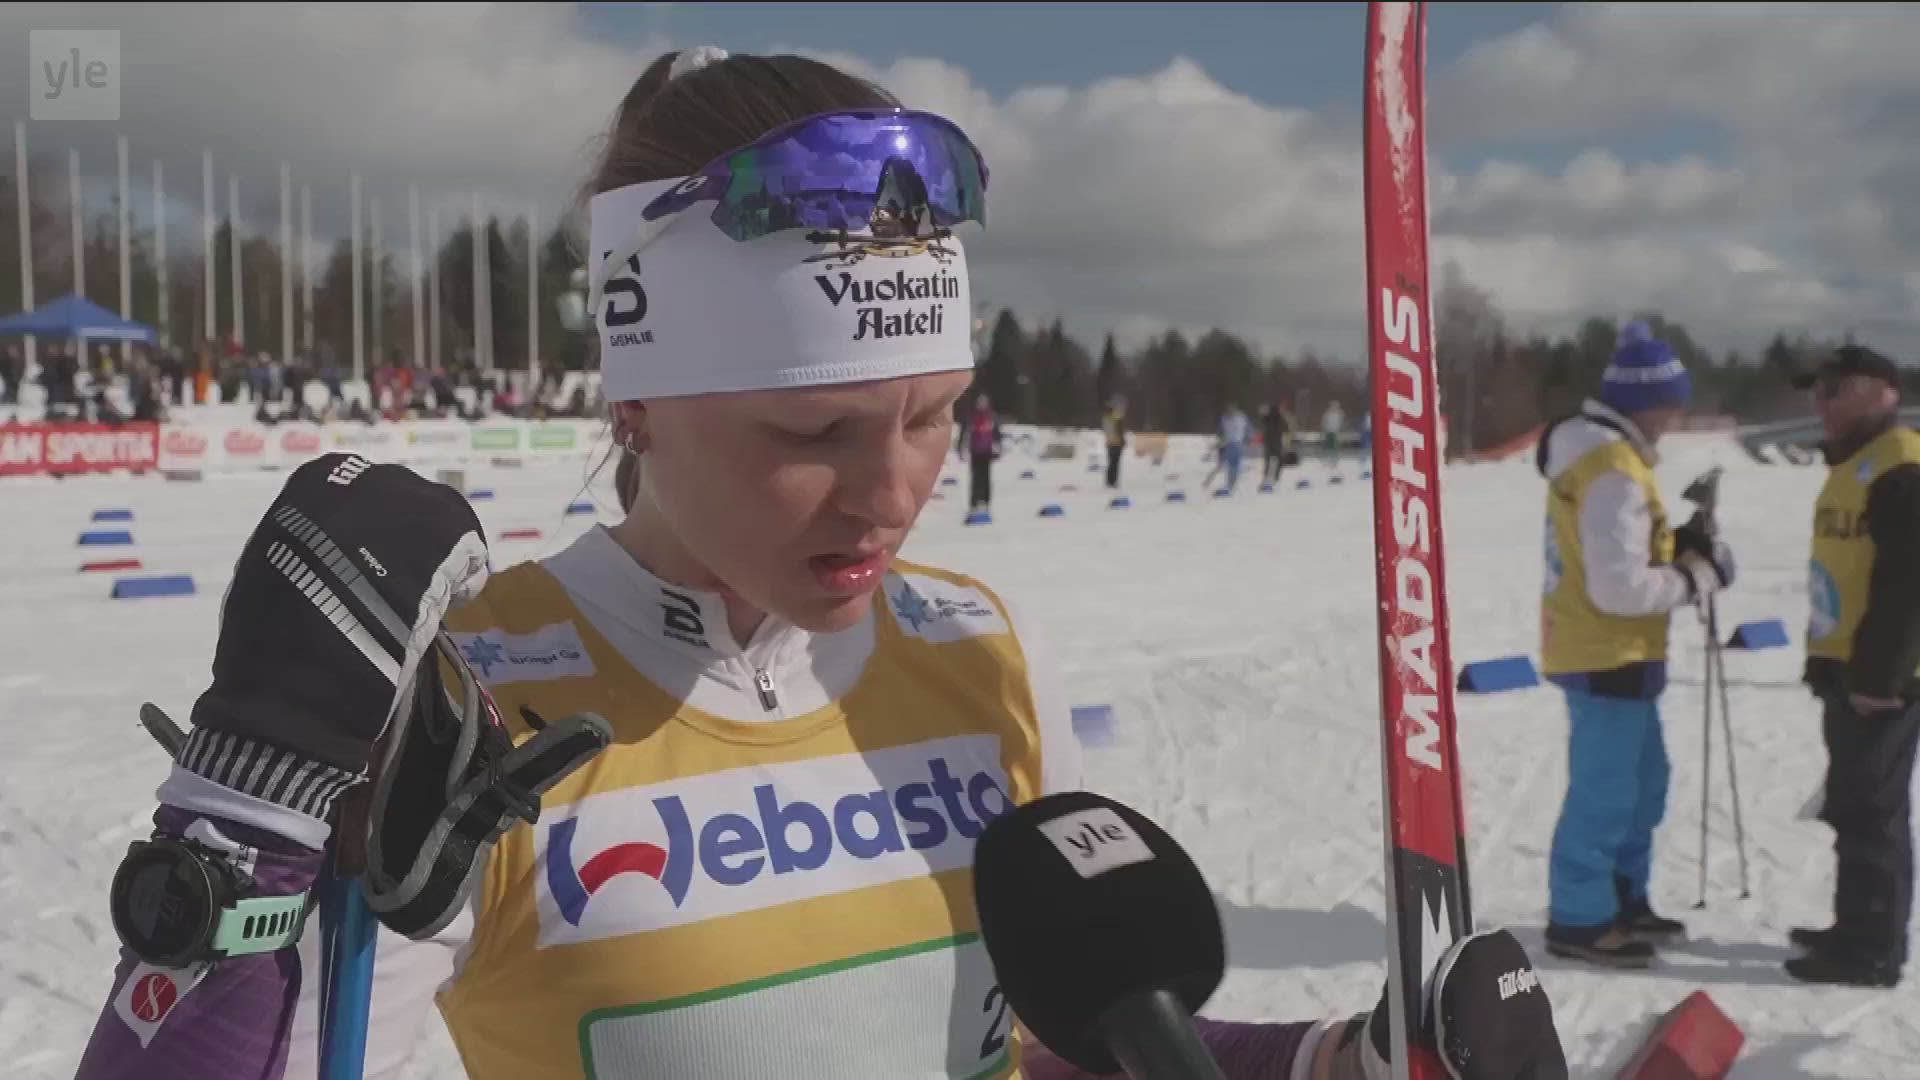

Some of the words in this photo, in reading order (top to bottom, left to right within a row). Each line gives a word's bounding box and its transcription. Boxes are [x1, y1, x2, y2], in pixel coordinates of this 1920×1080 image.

[814, 267, 960, 307] Vuokatin
[852, 303, 944, 341] Aateli
[1382, 287, 1442, 771] MADSHUS
[546, 757, 1016, 928] Webasto
[1063, 821, 1129, 859] yle
[979, 982, 1007, 1060] 2
